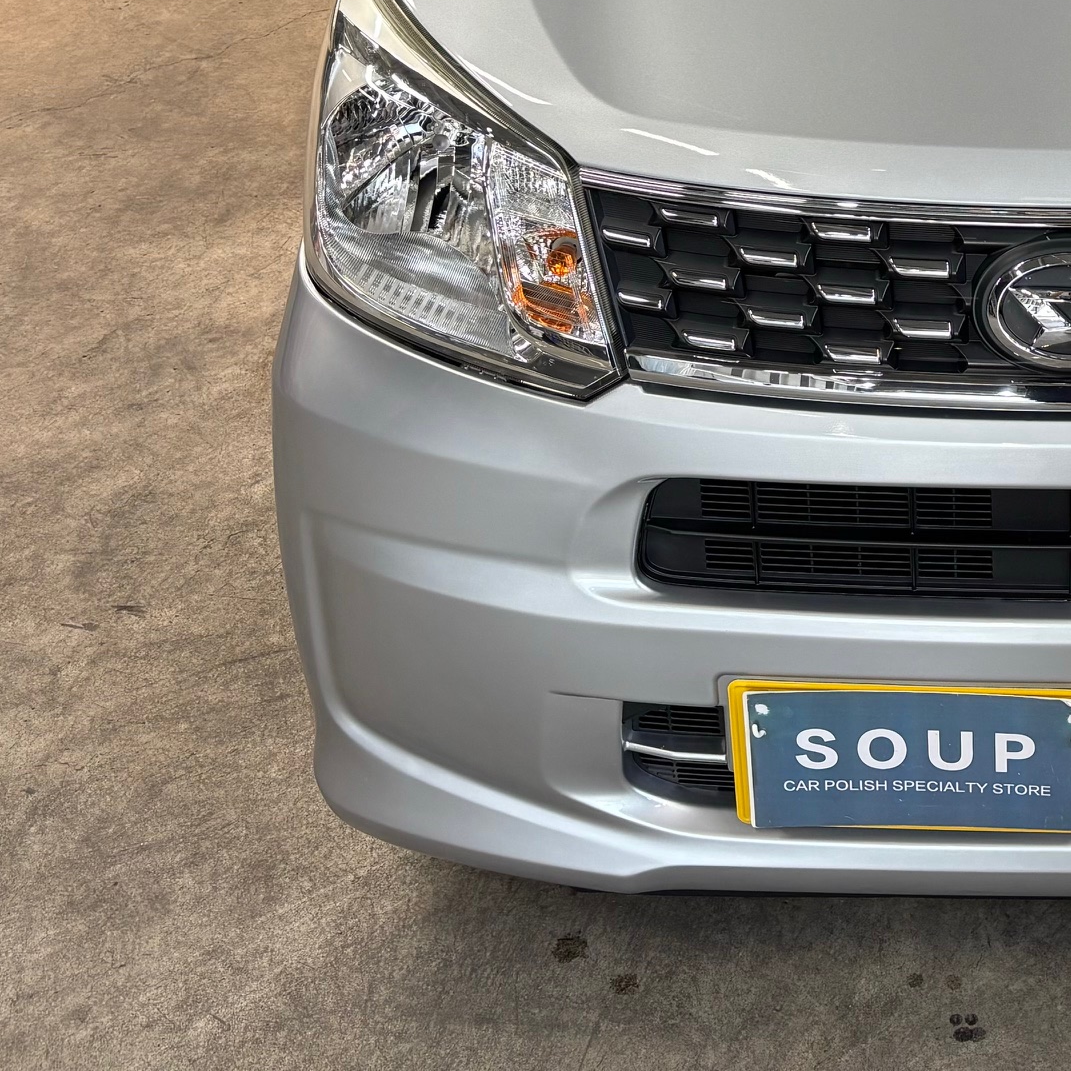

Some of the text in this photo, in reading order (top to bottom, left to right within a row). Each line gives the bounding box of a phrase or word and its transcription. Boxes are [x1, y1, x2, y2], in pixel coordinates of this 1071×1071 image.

[795, 728, 1036, 773] SOUP
[783, 780, 1051, 797] CAR POLISH SPECIALTY STORE
